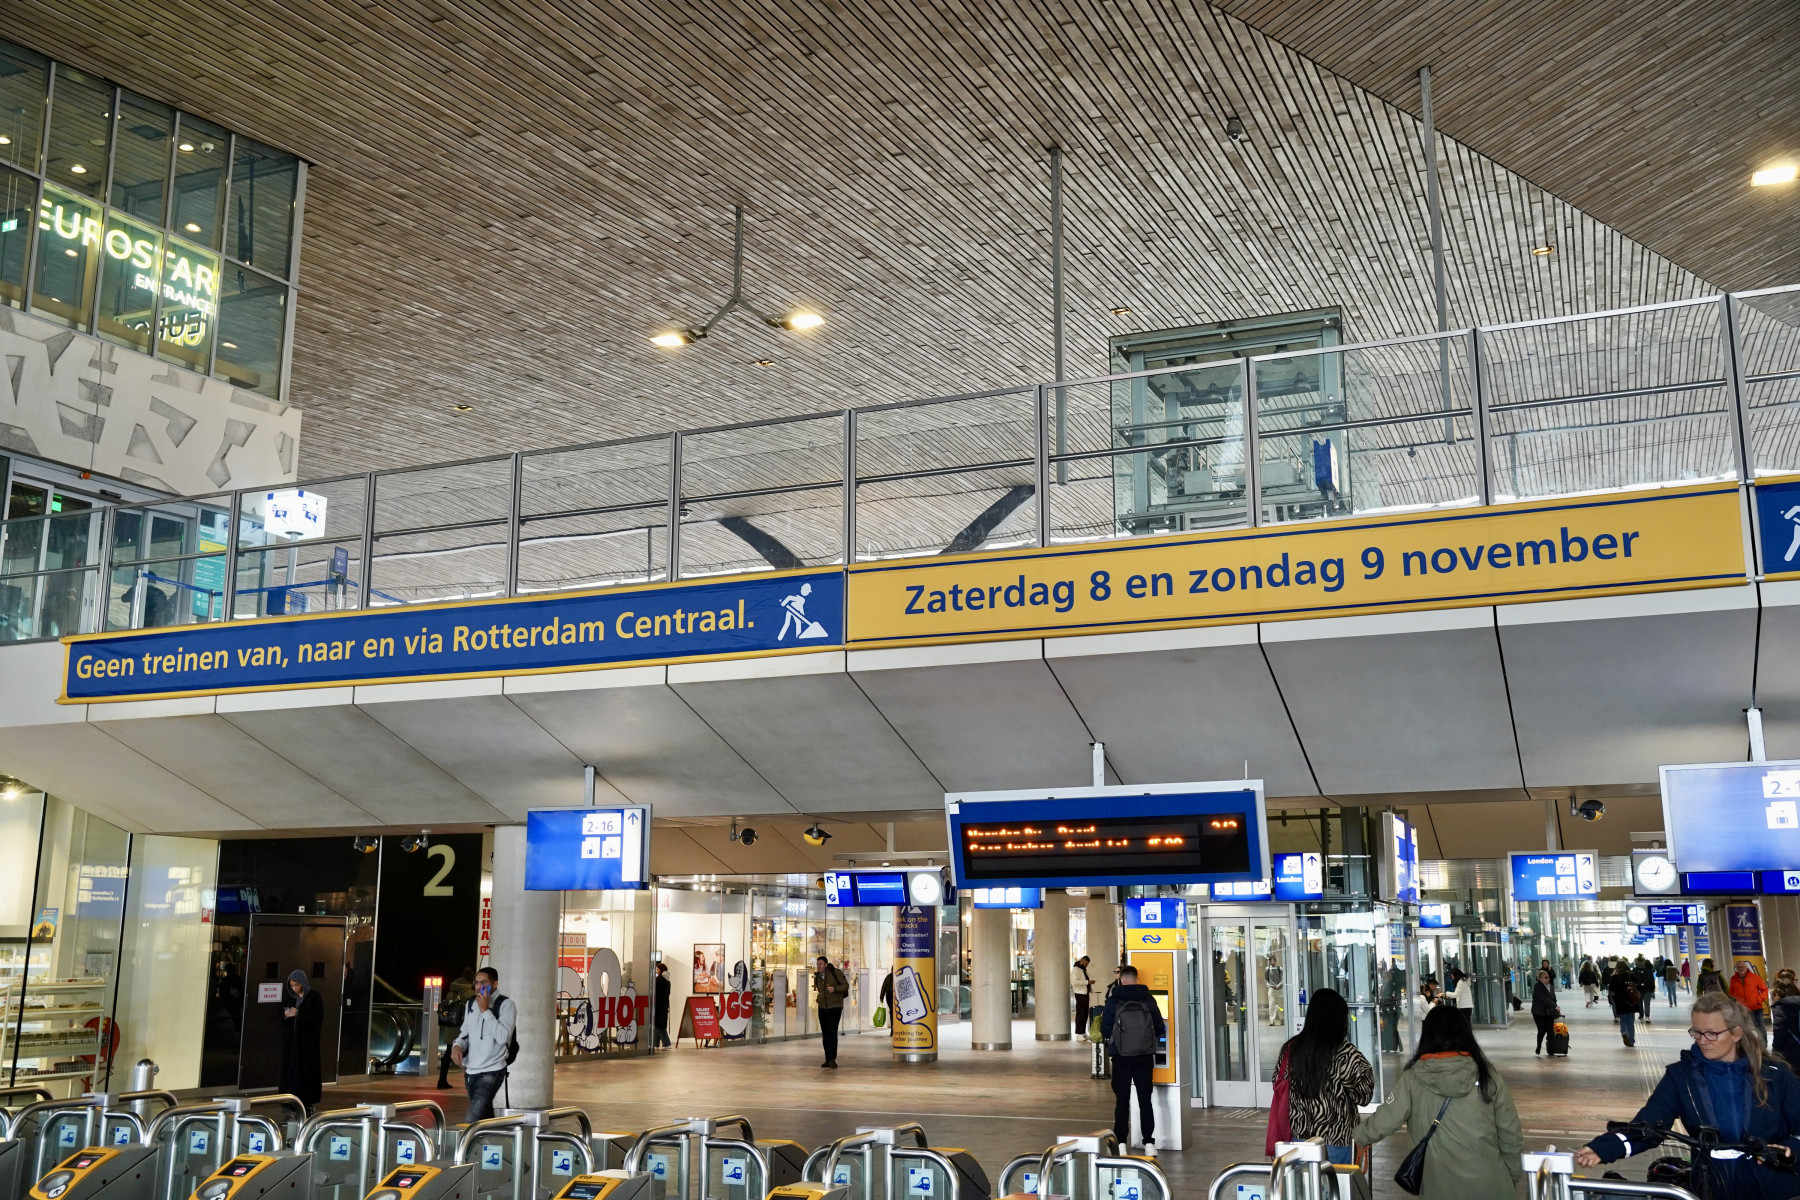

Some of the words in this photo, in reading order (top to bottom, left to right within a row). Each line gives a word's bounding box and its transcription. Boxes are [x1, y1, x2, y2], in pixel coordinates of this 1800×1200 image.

[135, 273, 213, 314] ENRANCE
[904, 574, 1075, 613] Zaterdag
[1090, 570, 1111, 601] 8
[1126, 571, 1173, 598] en
[1189, 552, 1345, 594] zondag
[1361, 546, 1385, 580] 9
[1402, 526, 1640, 576] november
[76, 655, 135, 679] Geen
[142, 647, 229, 675] treinen
[237, 645, 289, 668] van,
[297, 639, 356, 664] naar
[363, 637, 395, 659] en
[404, 627, 443, 655] via
[453, 616, 605, 652] Rotterdam
[615, 599, 755, 639] Centraal.
[423, 844, 456, 896] 2
[841, 880, 847, 888] 2
[597, 995, 649, 1029] HOT
